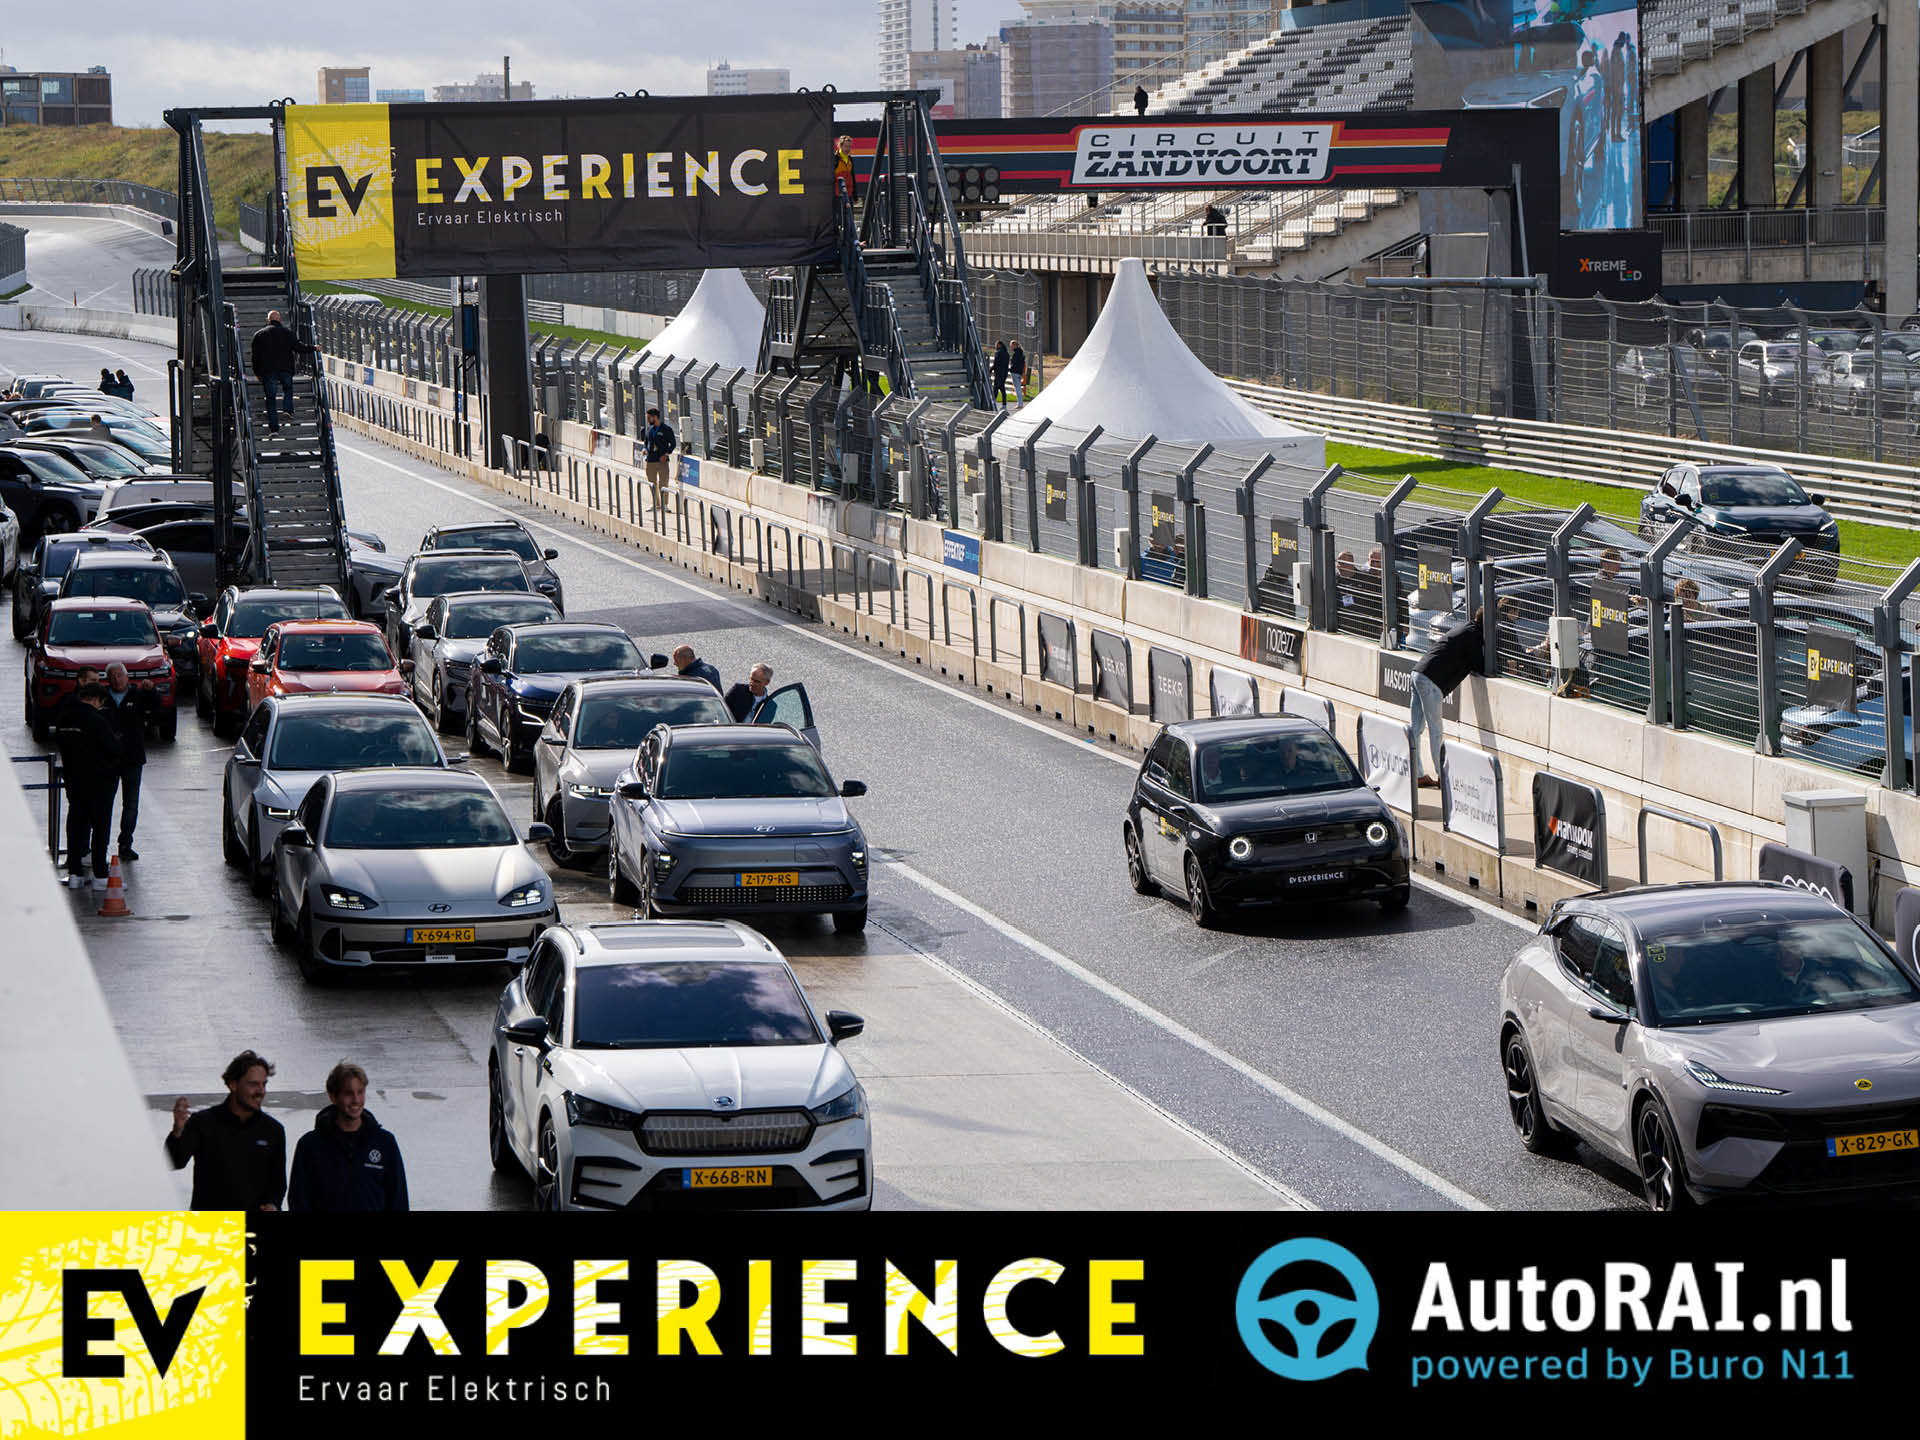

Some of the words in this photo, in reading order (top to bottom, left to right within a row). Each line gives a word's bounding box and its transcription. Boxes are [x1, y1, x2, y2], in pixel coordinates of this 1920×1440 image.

[1090, 131, 1319, 147] CIRCUIT
[1084, 147, 1318, 178] ZANDVOORT
[305, 165, 374, 218] EV
[415, 149, 805, 204] EXPERIENCE
[417, 212, 469, 226] Ervaar
[477, 209, 562, 224] Elektrisch
[1579, 258, 1627, 272] XTREME
[1620, 270, 1642, 281] LED
[1427, 570, 1452, 585] EXPERIENCE
[1601, 606, 1627, 624] EXPERIENCE
[1820, 657, 1854, 678] EXPERIENCE
[1158, 675, 1184, 697] ZEEKR
[746, 874, 792, 886] Z-179-RS
[1297, 871, 1344, 883] EXPERIENCE
[416, 930, 471, 942] X-694-RG
[1840, 1132, 1913, 1153] X-829-GK
[695, 1169, 767, 1185] X-668-RN
